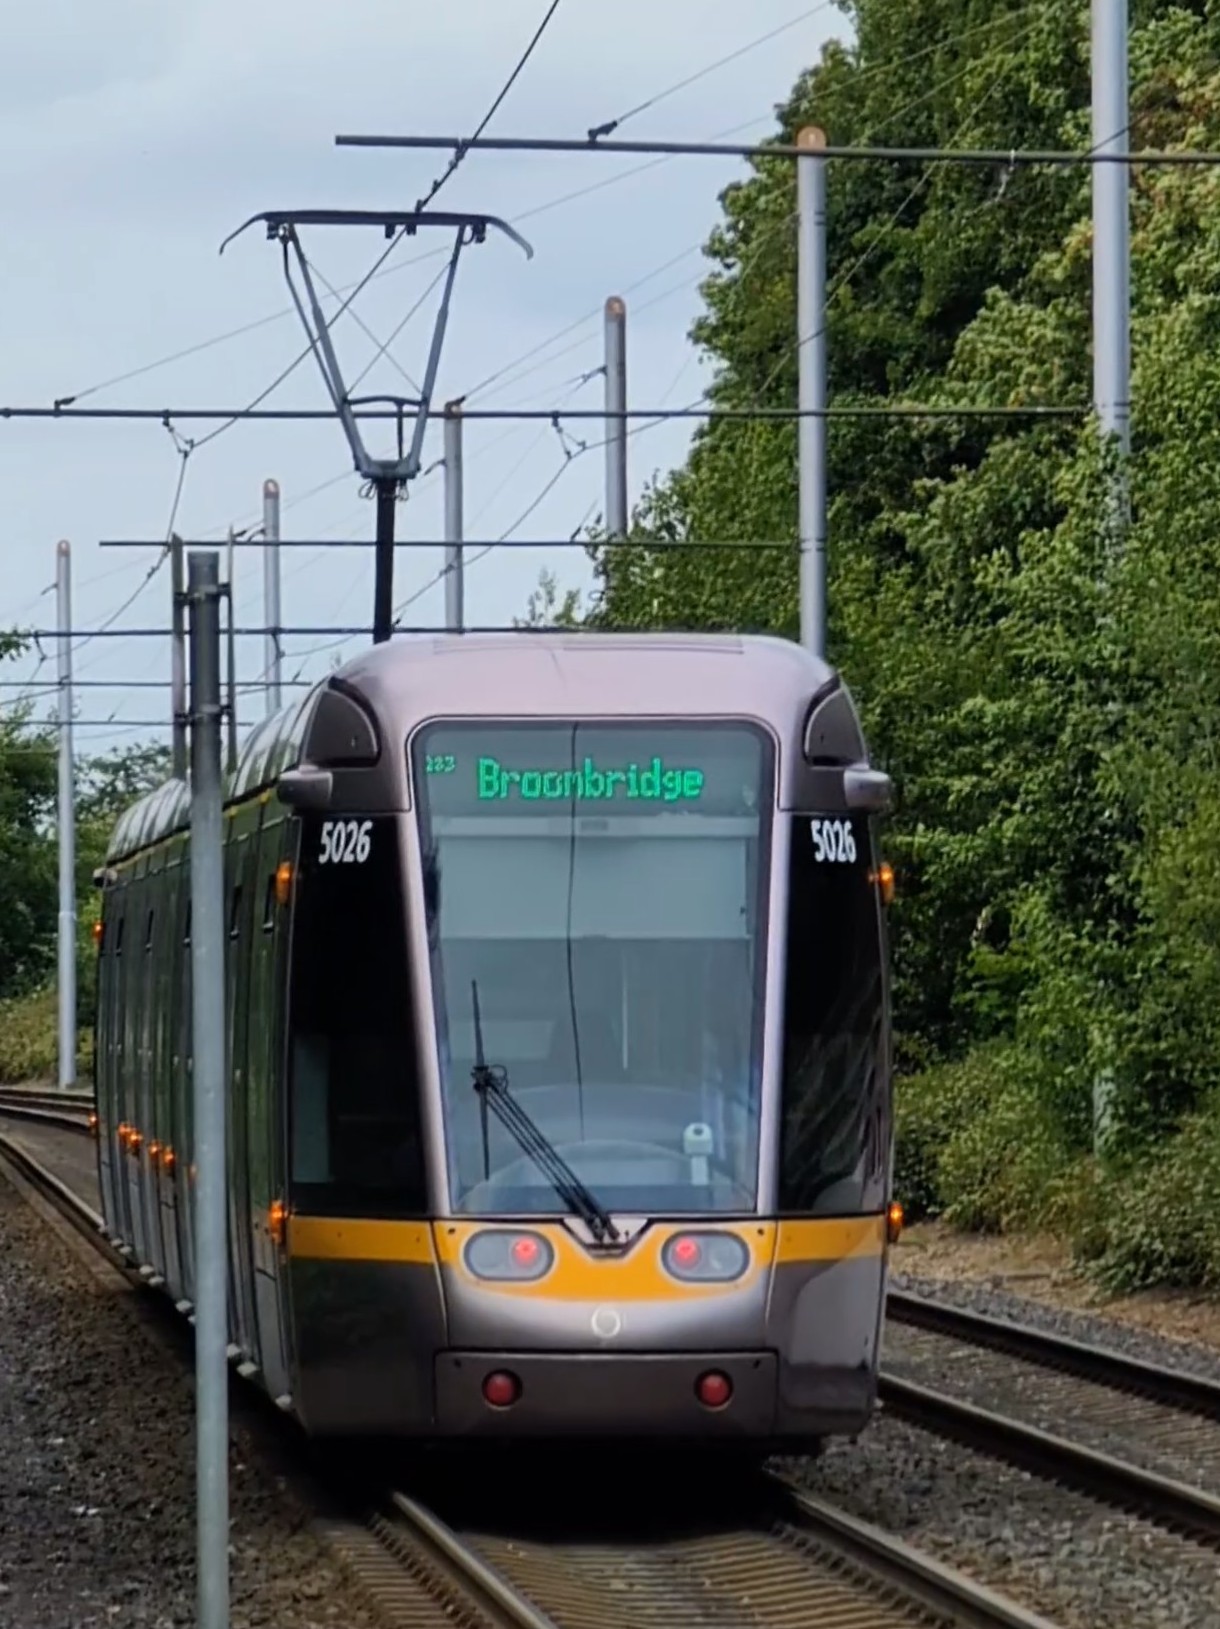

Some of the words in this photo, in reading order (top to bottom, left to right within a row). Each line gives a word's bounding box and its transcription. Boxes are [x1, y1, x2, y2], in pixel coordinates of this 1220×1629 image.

[477, 757, 705, 801] Broombridge
[318, 819, 374, 864] 5026
[810, 818, 857, 863] 5026
